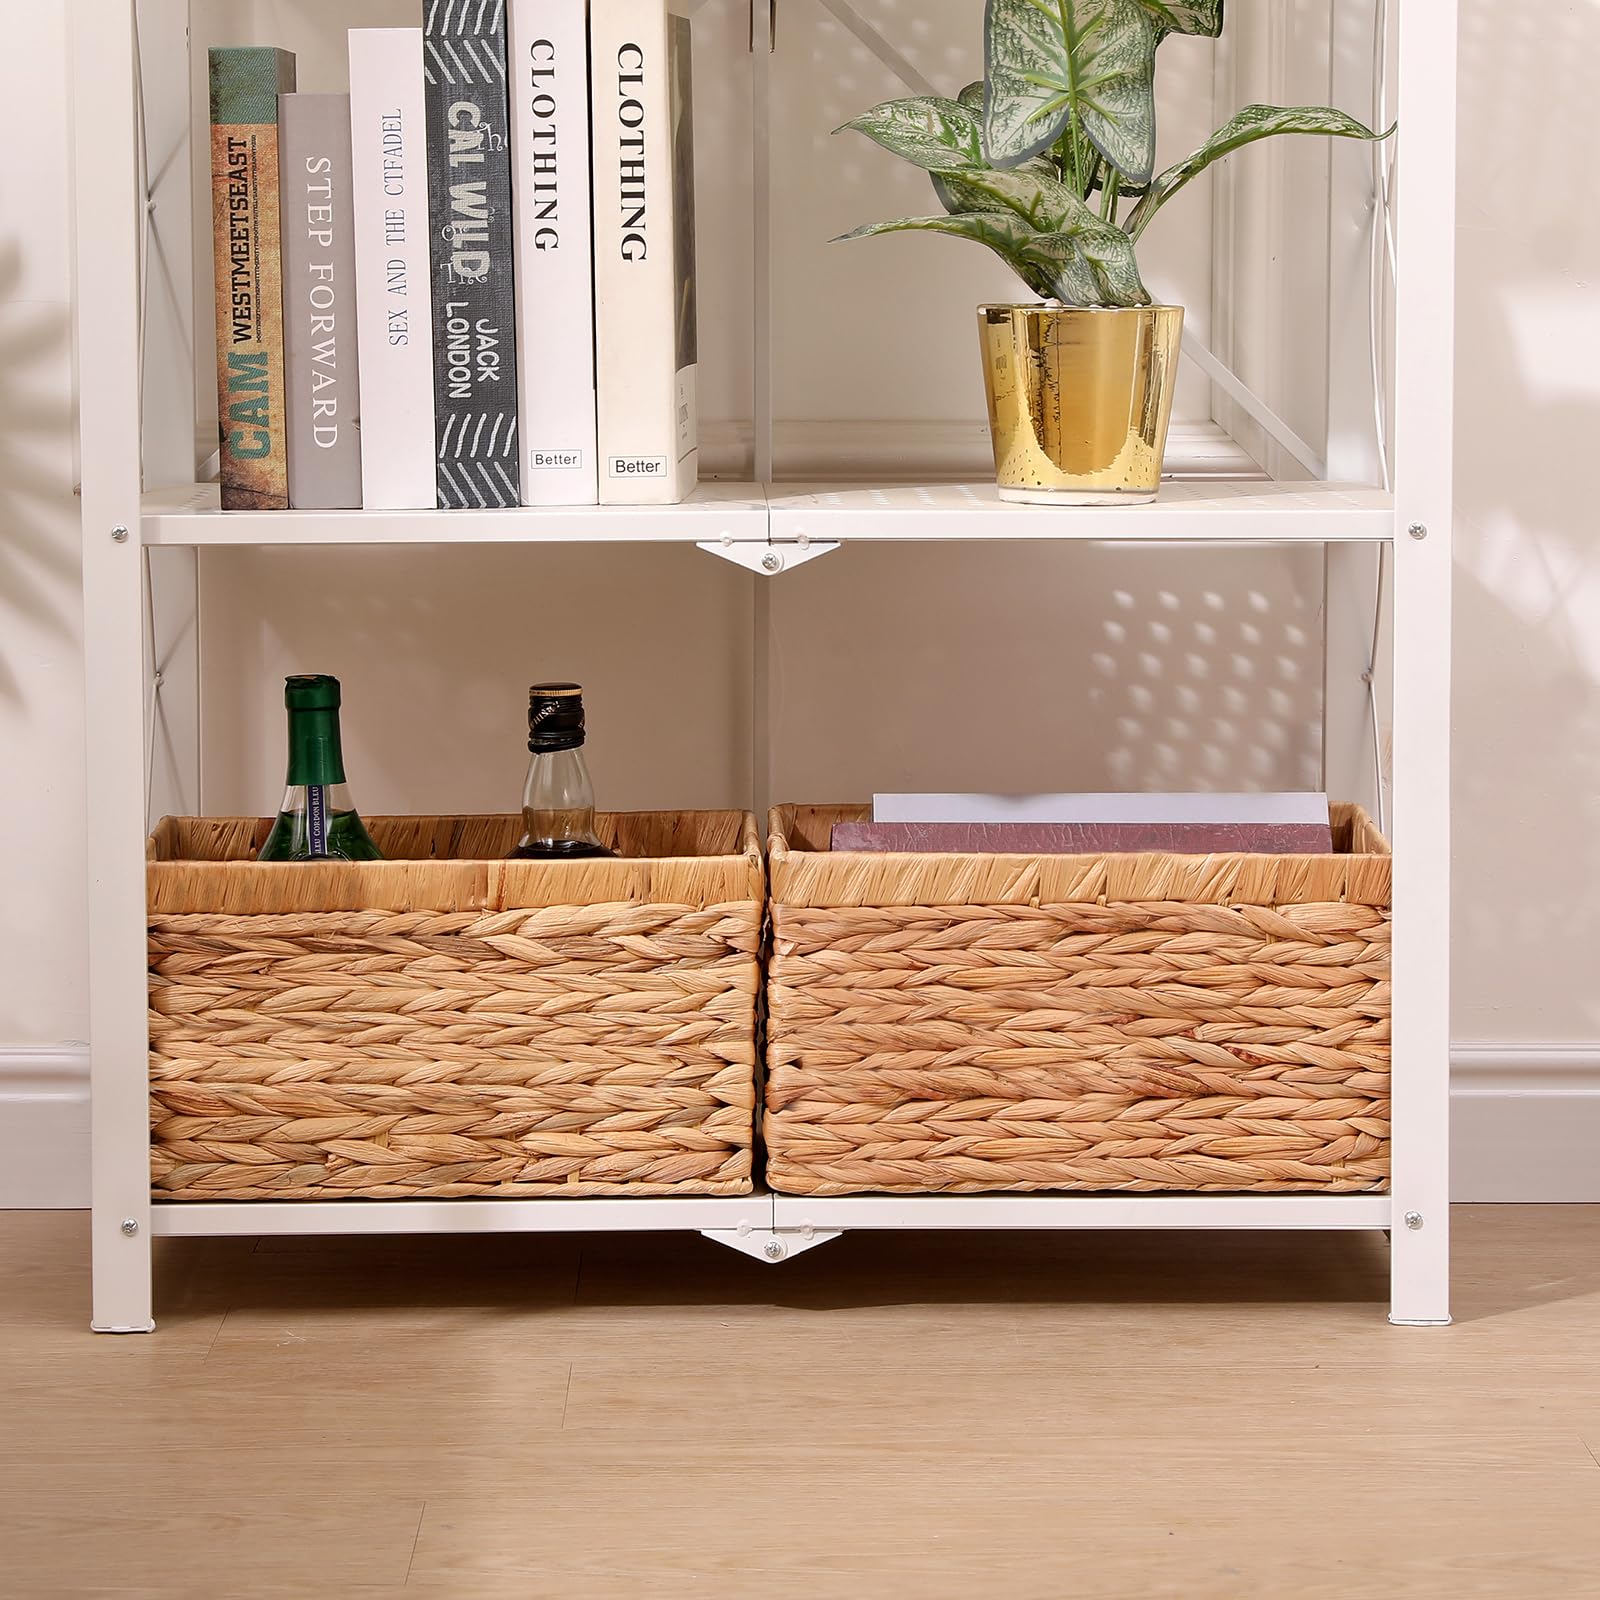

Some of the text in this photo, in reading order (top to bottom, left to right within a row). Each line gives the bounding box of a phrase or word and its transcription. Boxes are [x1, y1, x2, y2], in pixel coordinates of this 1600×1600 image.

[447, 101, 490, 278] CAL WILD
[530, 39, 559, 252] CLOTHING
[617, 42, 647, 263] CLOTHING
[227, 136, 252, 344] WESTMEETSEAST
[382, 108, 408, 346] SEX AND THE CTFADEL
[305, 156, 338, 449] STEP FORWARD
[445, 301, 472, 399] LONDON
[475, 318, 500, 382] JACK
[227, 351, 271, 460] CAM
[535, 454, 577, 465] Better
[615, 460, 660, 473] Better
[312, 806, 321, 837] CORDON
